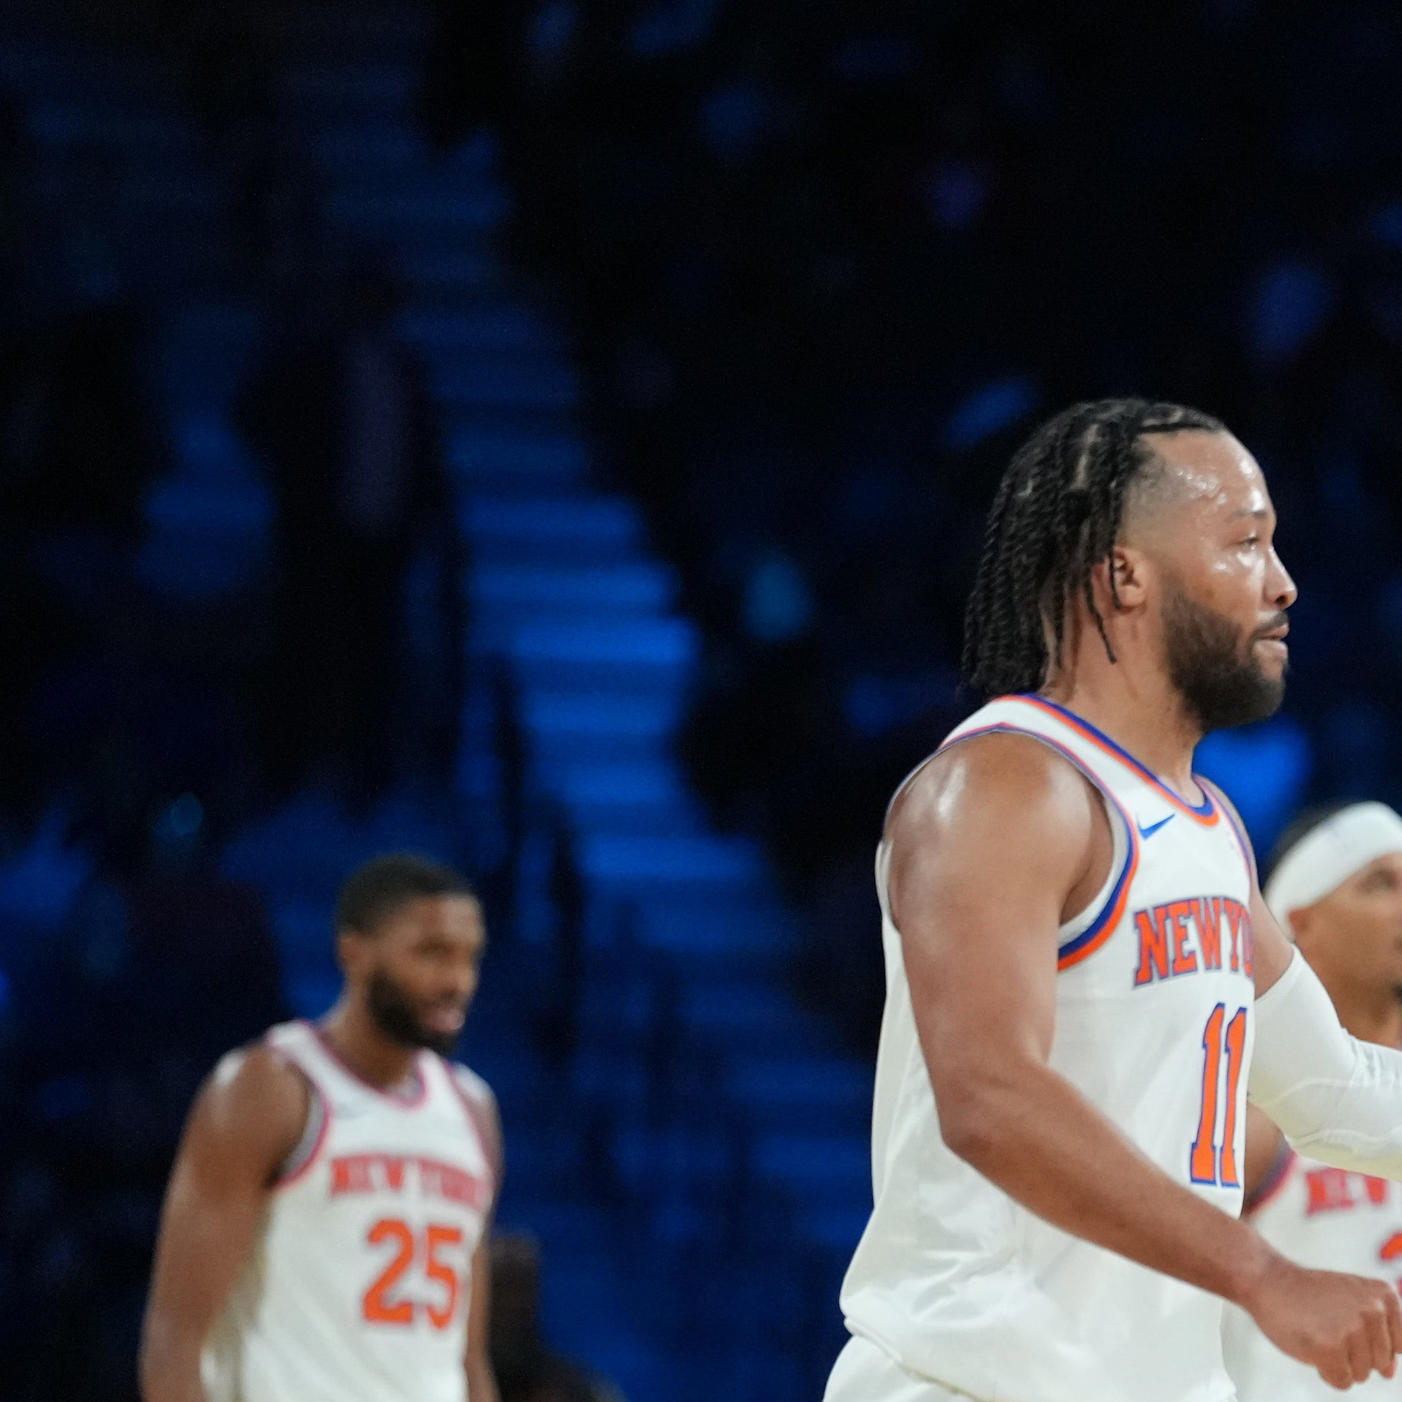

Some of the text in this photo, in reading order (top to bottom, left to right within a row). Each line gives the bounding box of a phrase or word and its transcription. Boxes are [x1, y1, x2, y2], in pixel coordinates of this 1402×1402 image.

[1132, 896, 1222, 988] NEW
[1189, 1001, 1248, 1189] 11
[361, 1215, 465, 1331] 25
